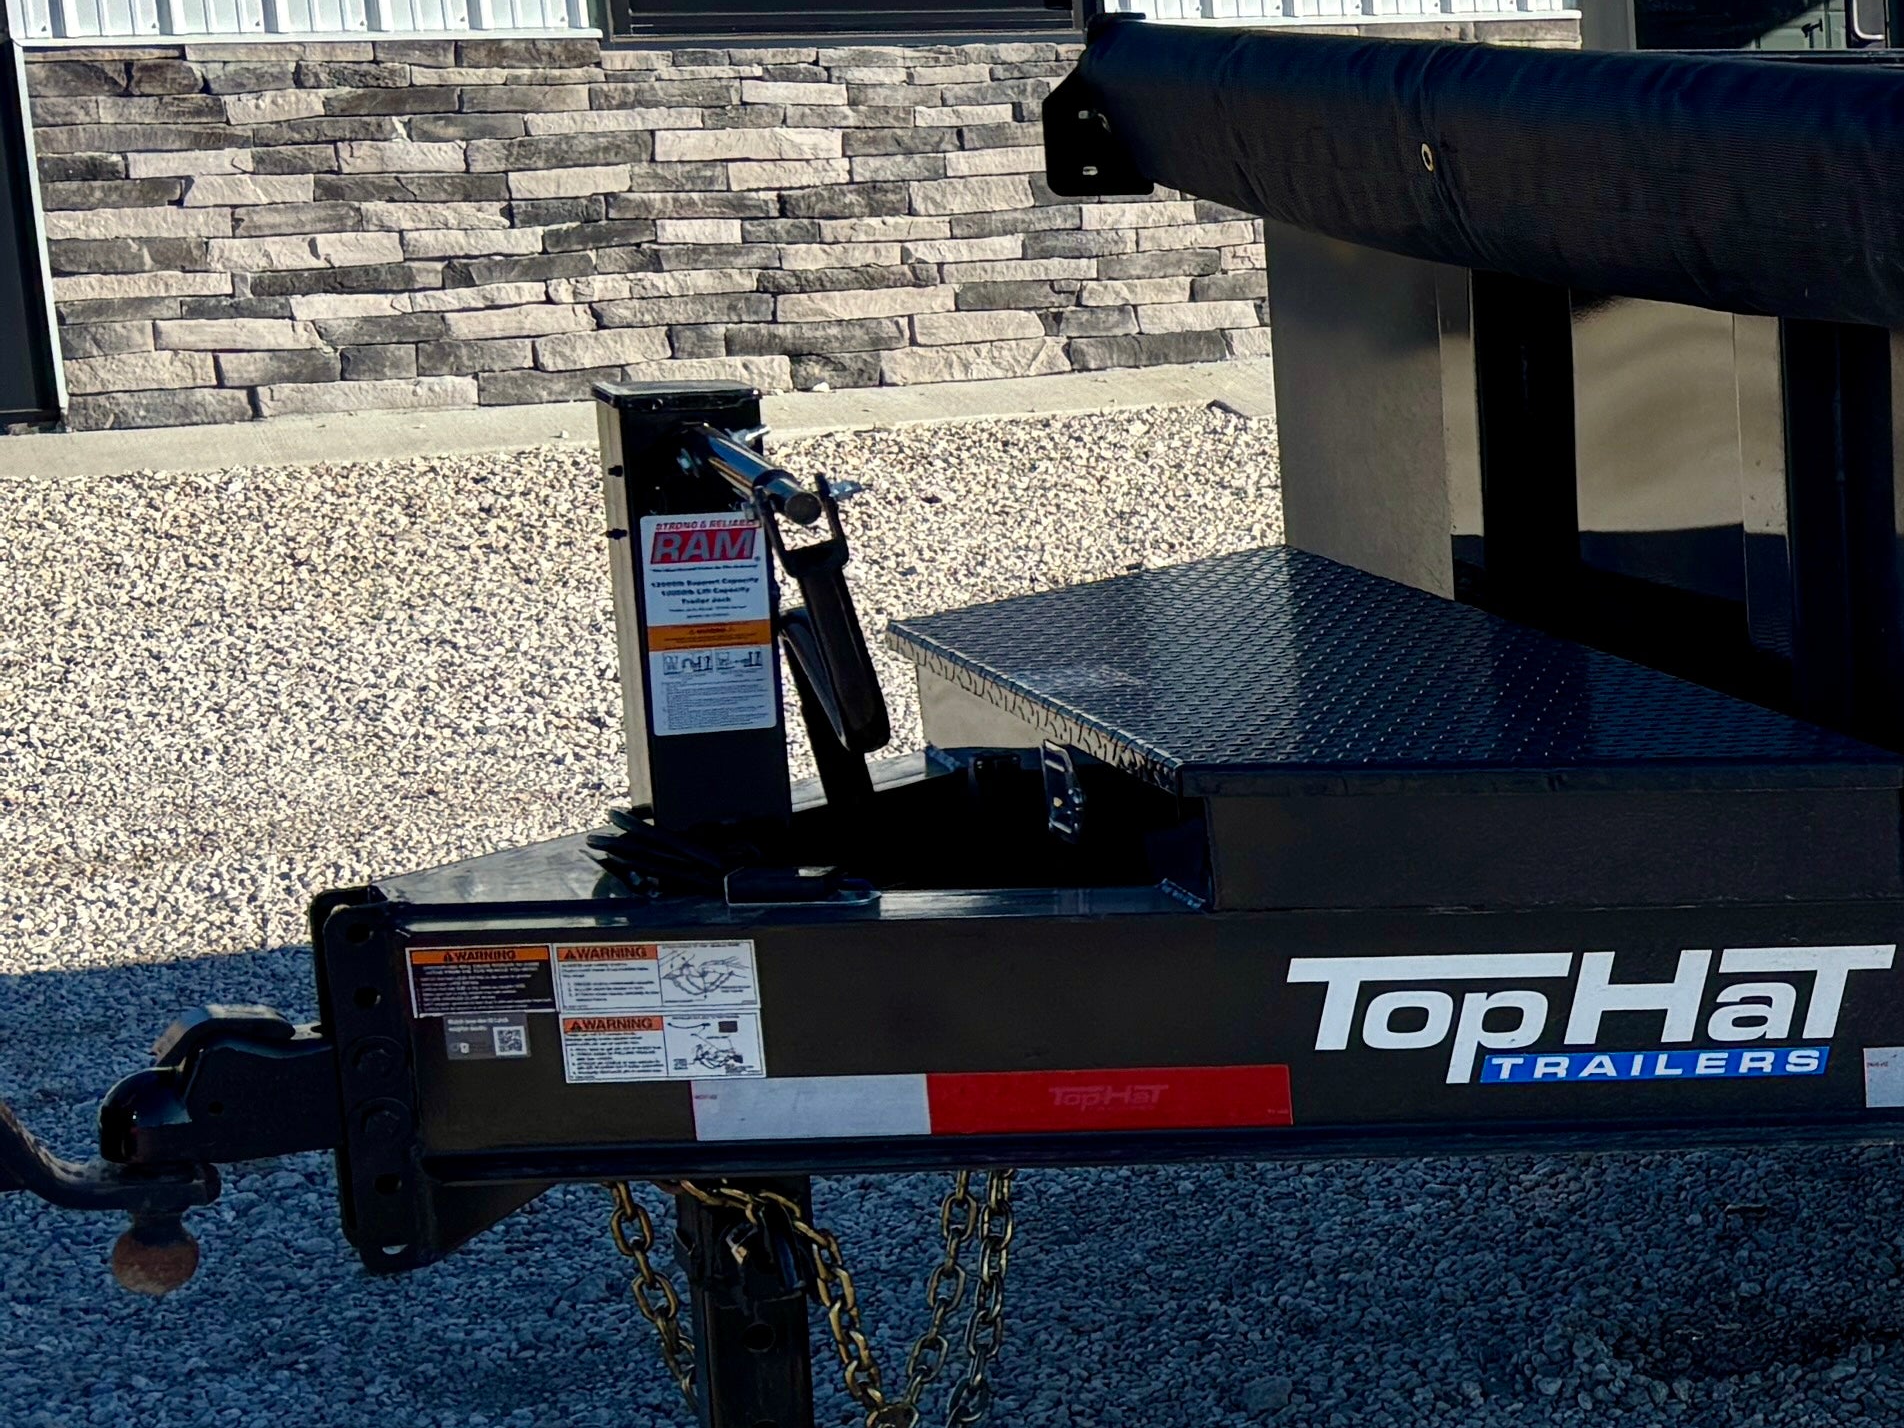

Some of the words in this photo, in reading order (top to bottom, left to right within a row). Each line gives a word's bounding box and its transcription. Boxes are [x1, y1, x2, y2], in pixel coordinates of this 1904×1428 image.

[652, 530, 756, 563] RAM
[455, 950, 516, 961] WARNING
[578, 947, 647, 960] WARNING
[583, 1018, 653, 1031] WARNING
[1491, 1050, 1820, 1080] TRAILERS
